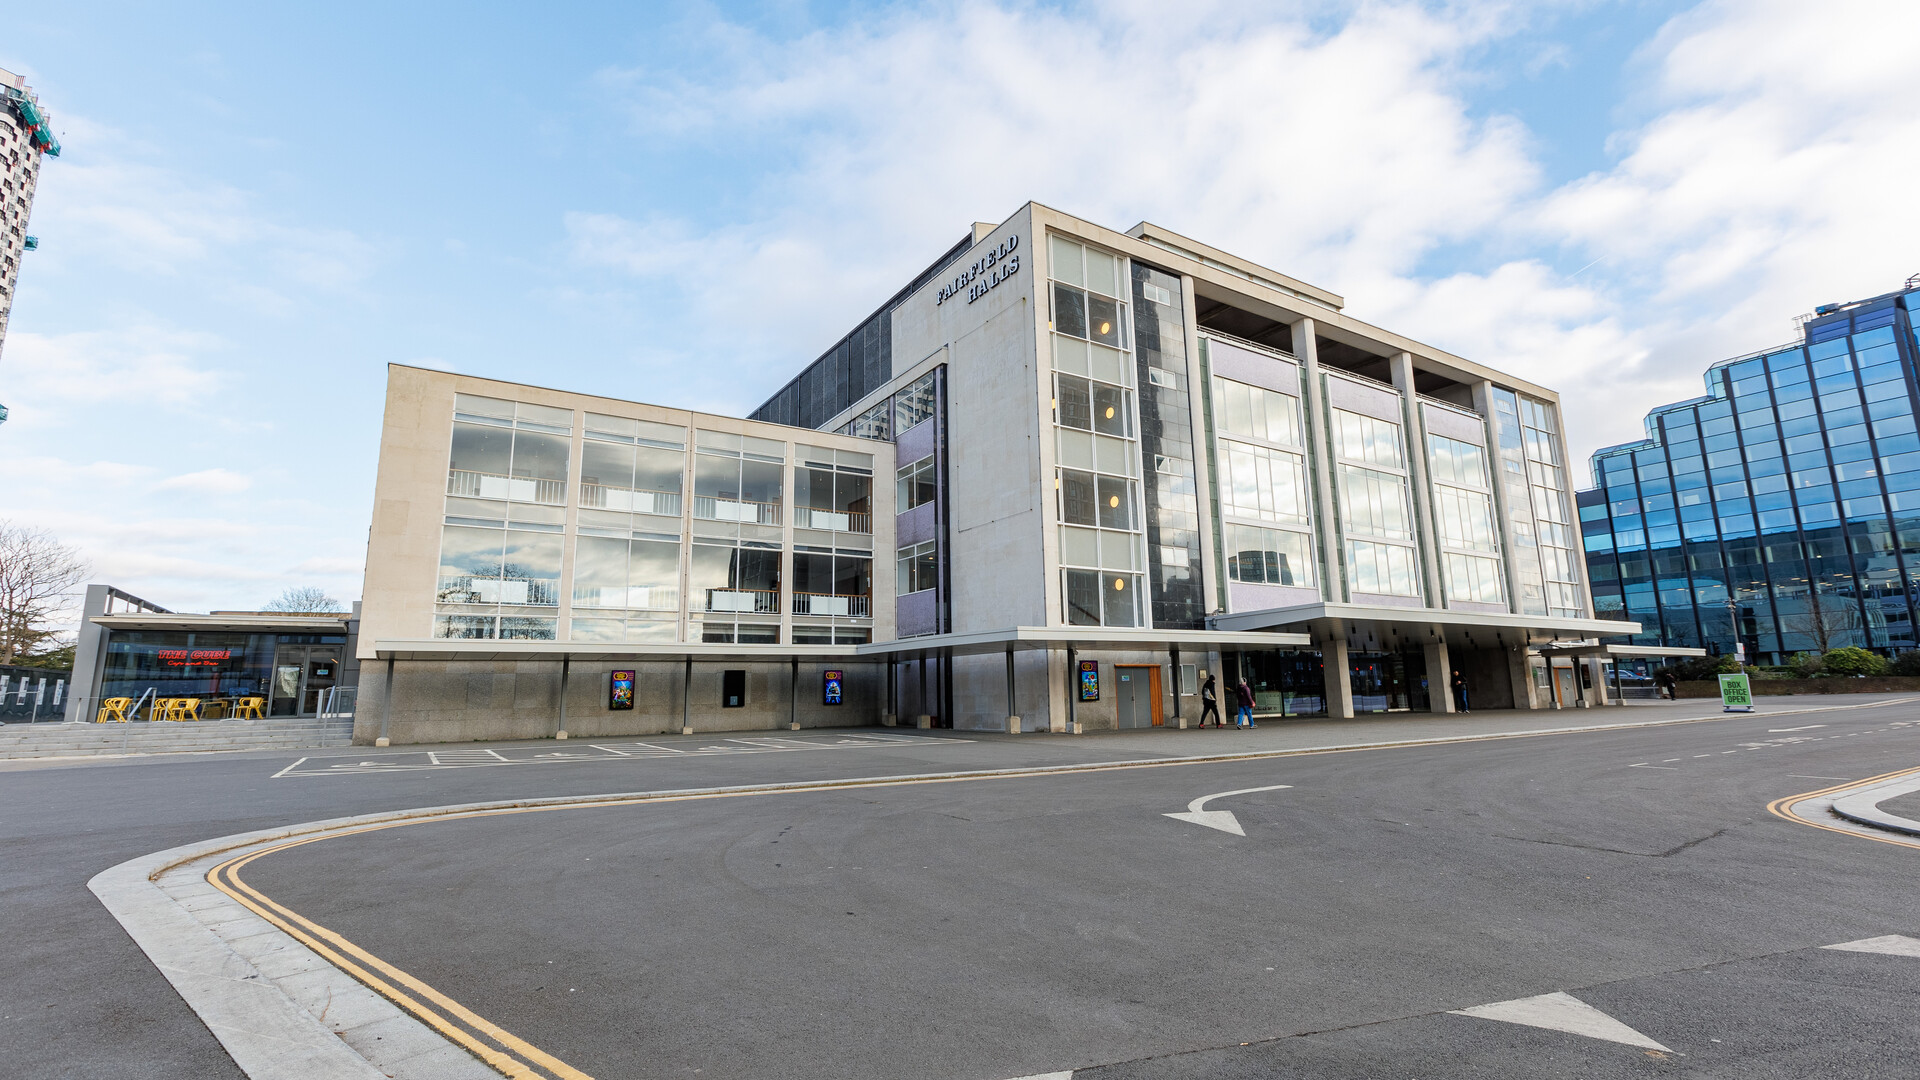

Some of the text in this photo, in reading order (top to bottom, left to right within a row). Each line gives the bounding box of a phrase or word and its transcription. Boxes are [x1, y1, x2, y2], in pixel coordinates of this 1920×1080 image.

[936, 234, 1019, 306] FAIRFIELD
[968, 255, 1020, 304] HALLS
[158, 650, 231, 659] THE CUBE
[1723, 688, 1748, 696] OFFICE
